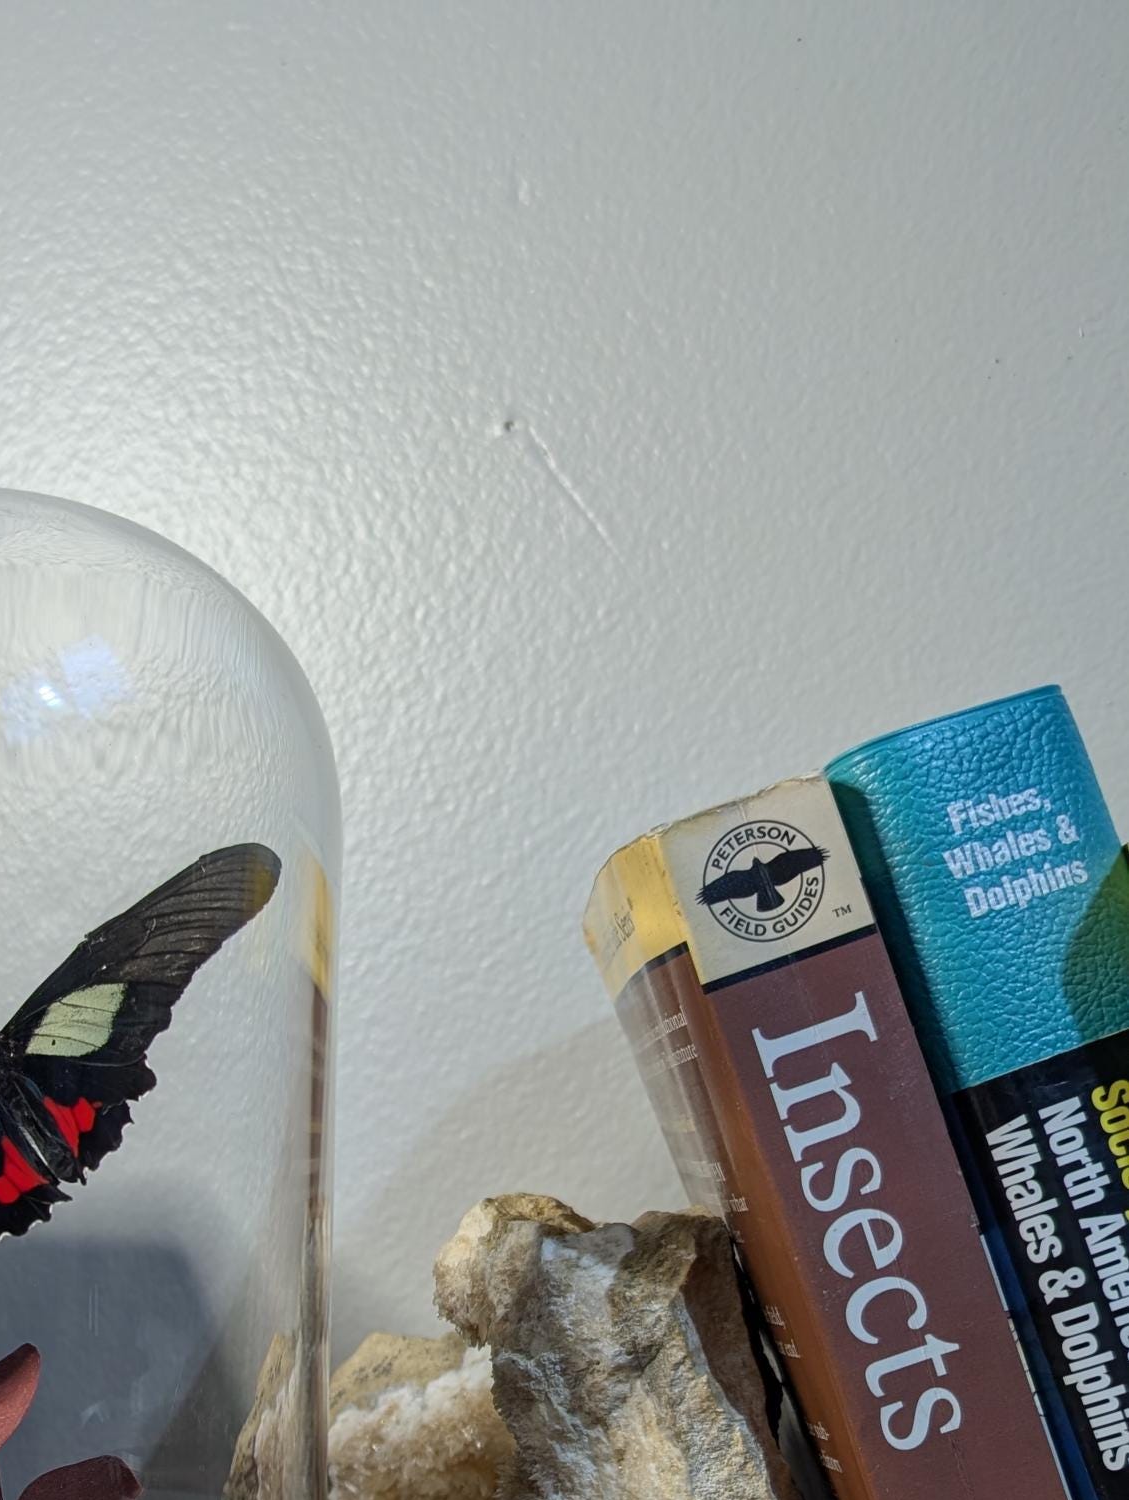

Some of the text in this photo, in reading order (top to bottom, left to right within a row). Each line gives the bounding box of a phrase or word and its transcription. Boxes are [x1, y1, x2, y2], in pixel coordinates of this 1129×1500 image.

[947, 788, 1052, 836] Fishes,
[711, 826, 797, 871] PETERSON
[943, 814, 1080, 879] Whales &
[719, 876, 819, 937] FIELD GUIDES
[963, 860, 1089, 919] Dolphins
[1037, 1096, 1111, 1210] North
[751, 991, 962, 1451] Insects
[985, 1113, 1129, 1471] Whales & Dolphins
